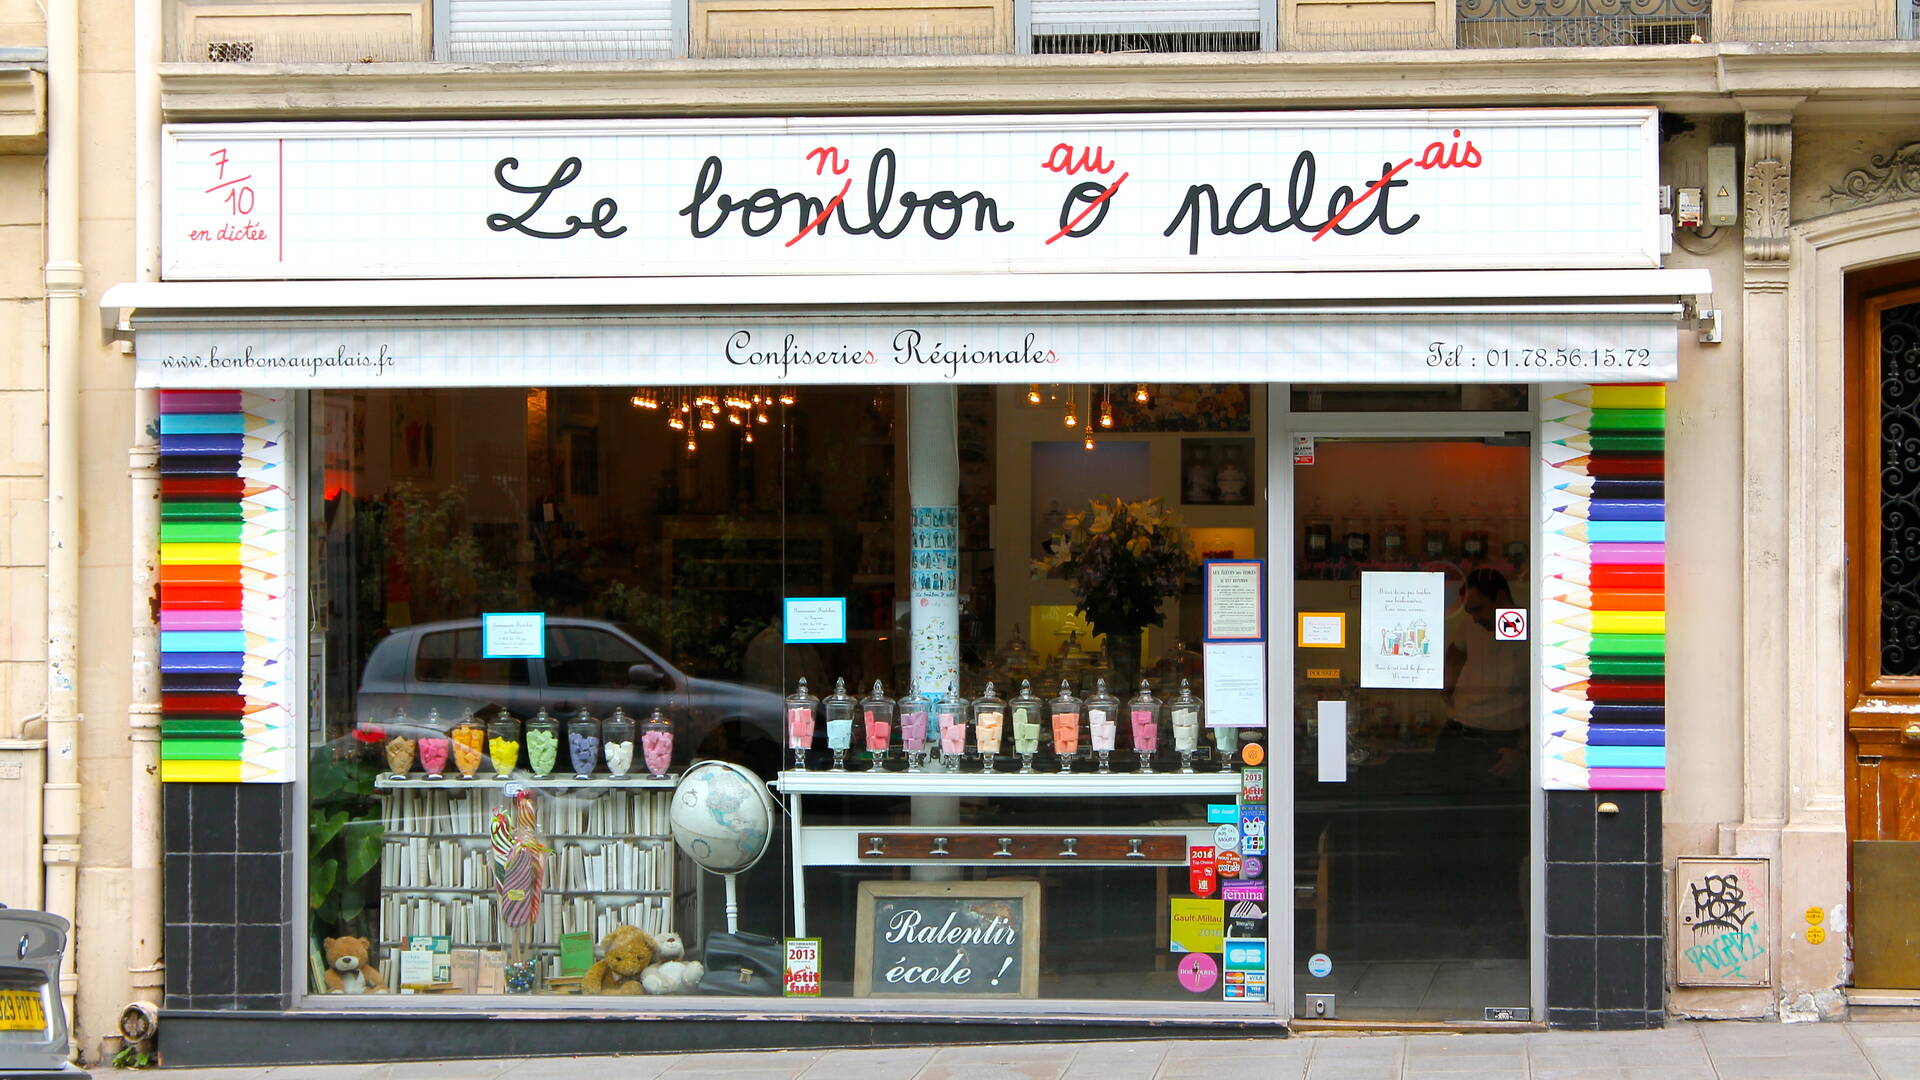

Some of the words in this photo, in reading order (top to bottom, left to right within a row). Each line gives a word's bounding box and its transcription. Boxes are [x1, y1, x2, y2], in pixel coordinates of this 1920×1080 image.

[210, 148, 229, 180] 7
[806, 147, 850, 175] n
[1041, 143, 1115, 175] au
[1416, 128, 1483, 169] ais
[224, 186, 254, 215] 10
[486, 156, 627, 240] Le
[1164, 150, 1420, 255] palet
[189, 228, 212, 241] en
[217, 219, 267, 241] dictée
[161, 343, 395, 377] www.bonbonsaupalais.fr
[725, 329, 879, 379] Confiseries
[892, 328, 1060, 378] Régionales
[1486, 347, 1651, 368] 01.78.56.15.72
[1245, 773, 1262, 781] 2013
[1223, 888, 1264, 900] femina
[885, 909, 1016, 945] Ralentir
[789, 949, 816, 960] 2013
[885, 954, 971, 985] école
